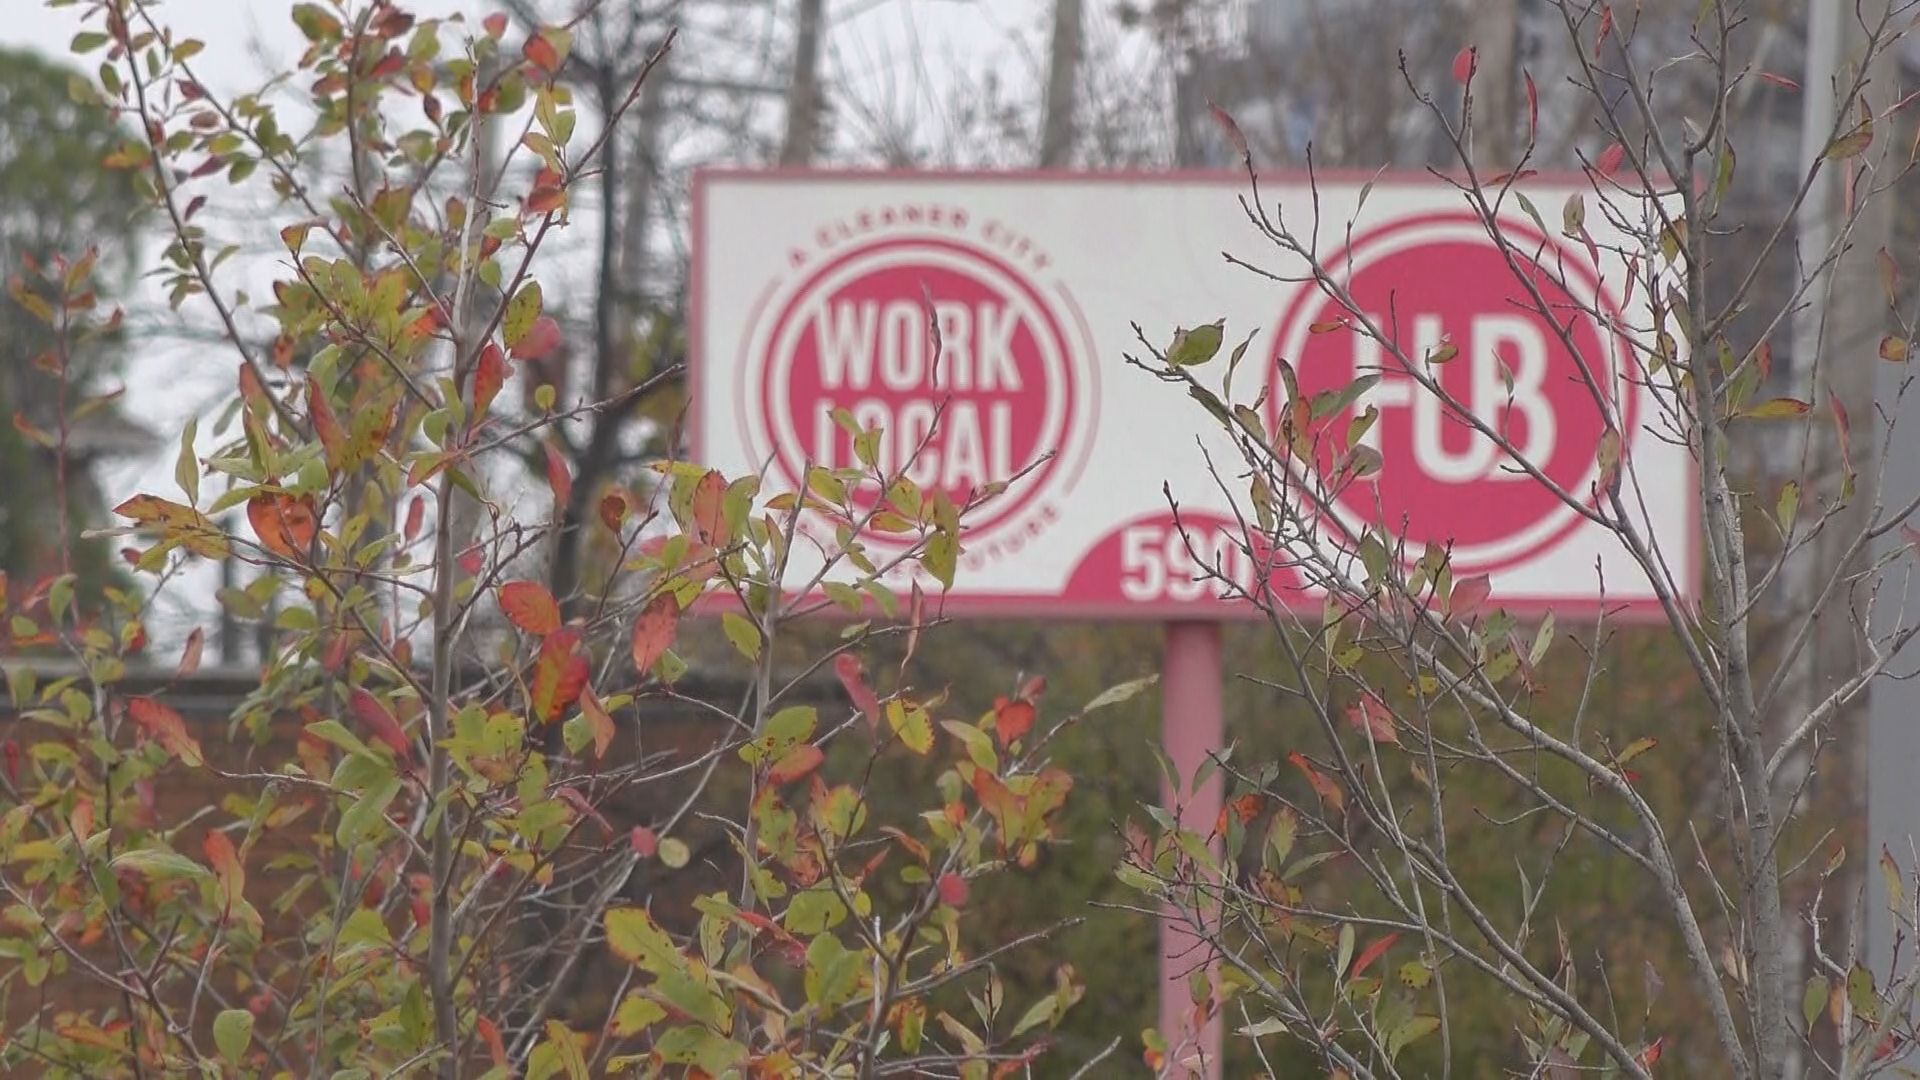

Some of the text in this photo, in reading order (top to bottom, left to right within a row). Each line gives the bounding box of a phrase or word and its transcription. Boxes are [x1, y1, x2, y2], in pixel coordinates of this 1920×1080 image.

[814, 204, 970, 248] CLEANER
[979, 216, 1053, 273] CITY
[814, 299, 1024, 392] WORK
[1353, 313, 1557, 484] HUB
[955, 499, 1062, 574] UTURE
[1120, 523, 1251, 603] 590
